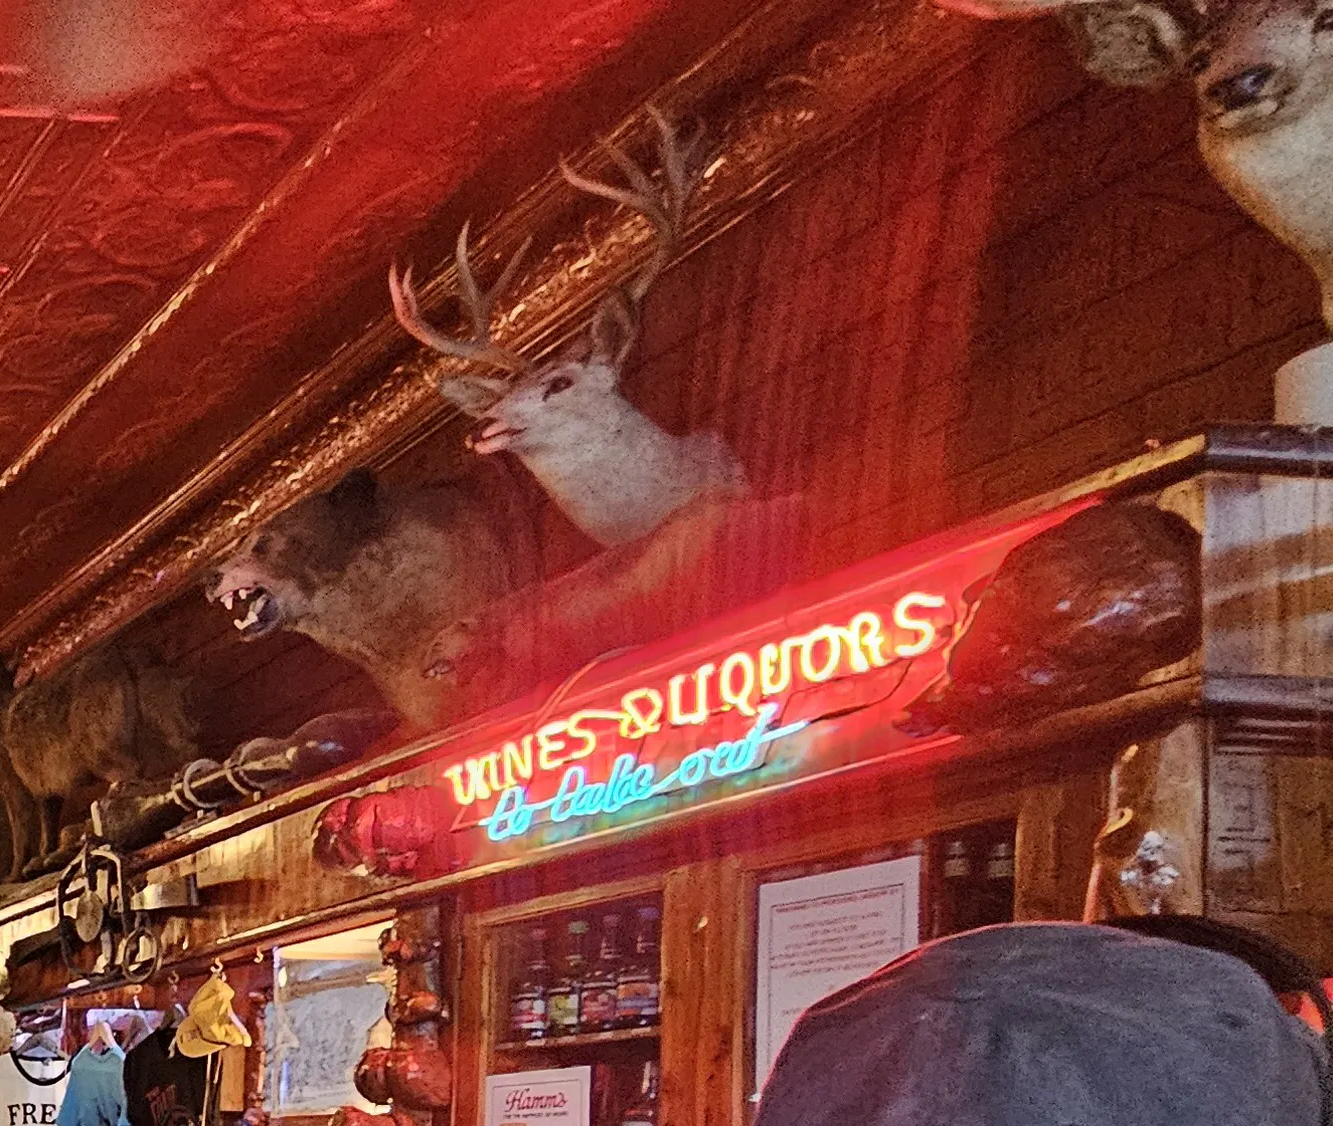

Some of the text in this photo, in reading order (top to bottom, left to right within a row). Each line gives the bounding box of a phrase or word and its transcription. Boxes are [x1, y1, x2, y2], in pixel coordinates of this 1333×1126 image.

[444, 592, 945, 805] WINES & LIQUORS
[7, 1103, 57, 1126] FRE
